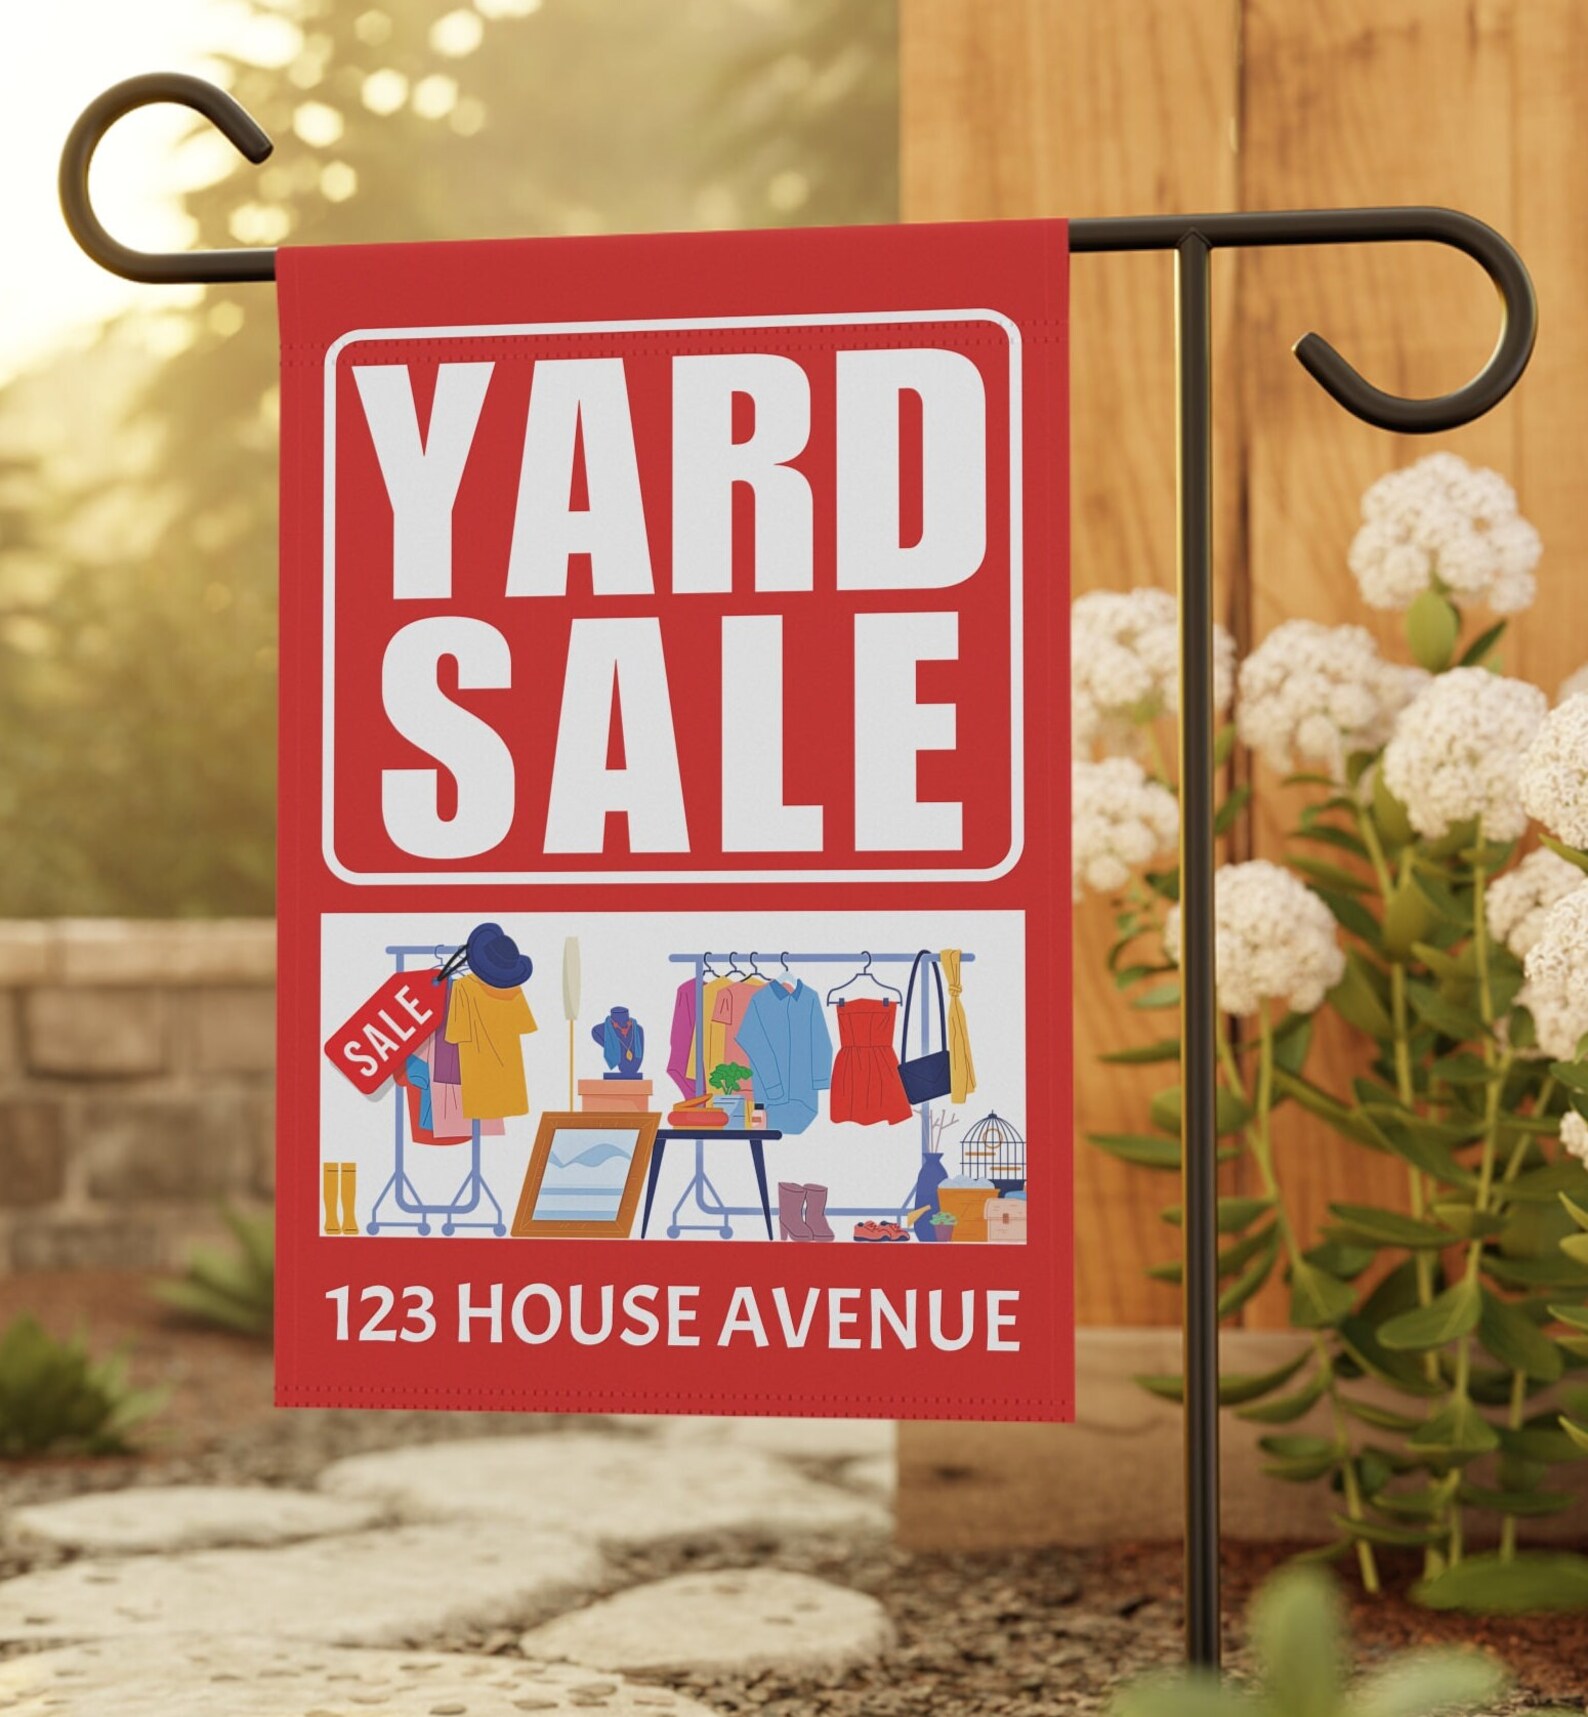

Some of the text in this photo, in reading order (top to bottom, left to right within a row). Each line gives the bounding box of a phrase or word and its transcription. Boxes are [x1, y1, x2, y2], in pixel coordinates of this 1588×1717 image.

[352, 349, 987, 600] YARD
[381, 612, 963, 860] SALE
[343, 985, 433, 1077] SALE
[325, 1282, 1020, 1352] 123 HOUSE AVENUE
